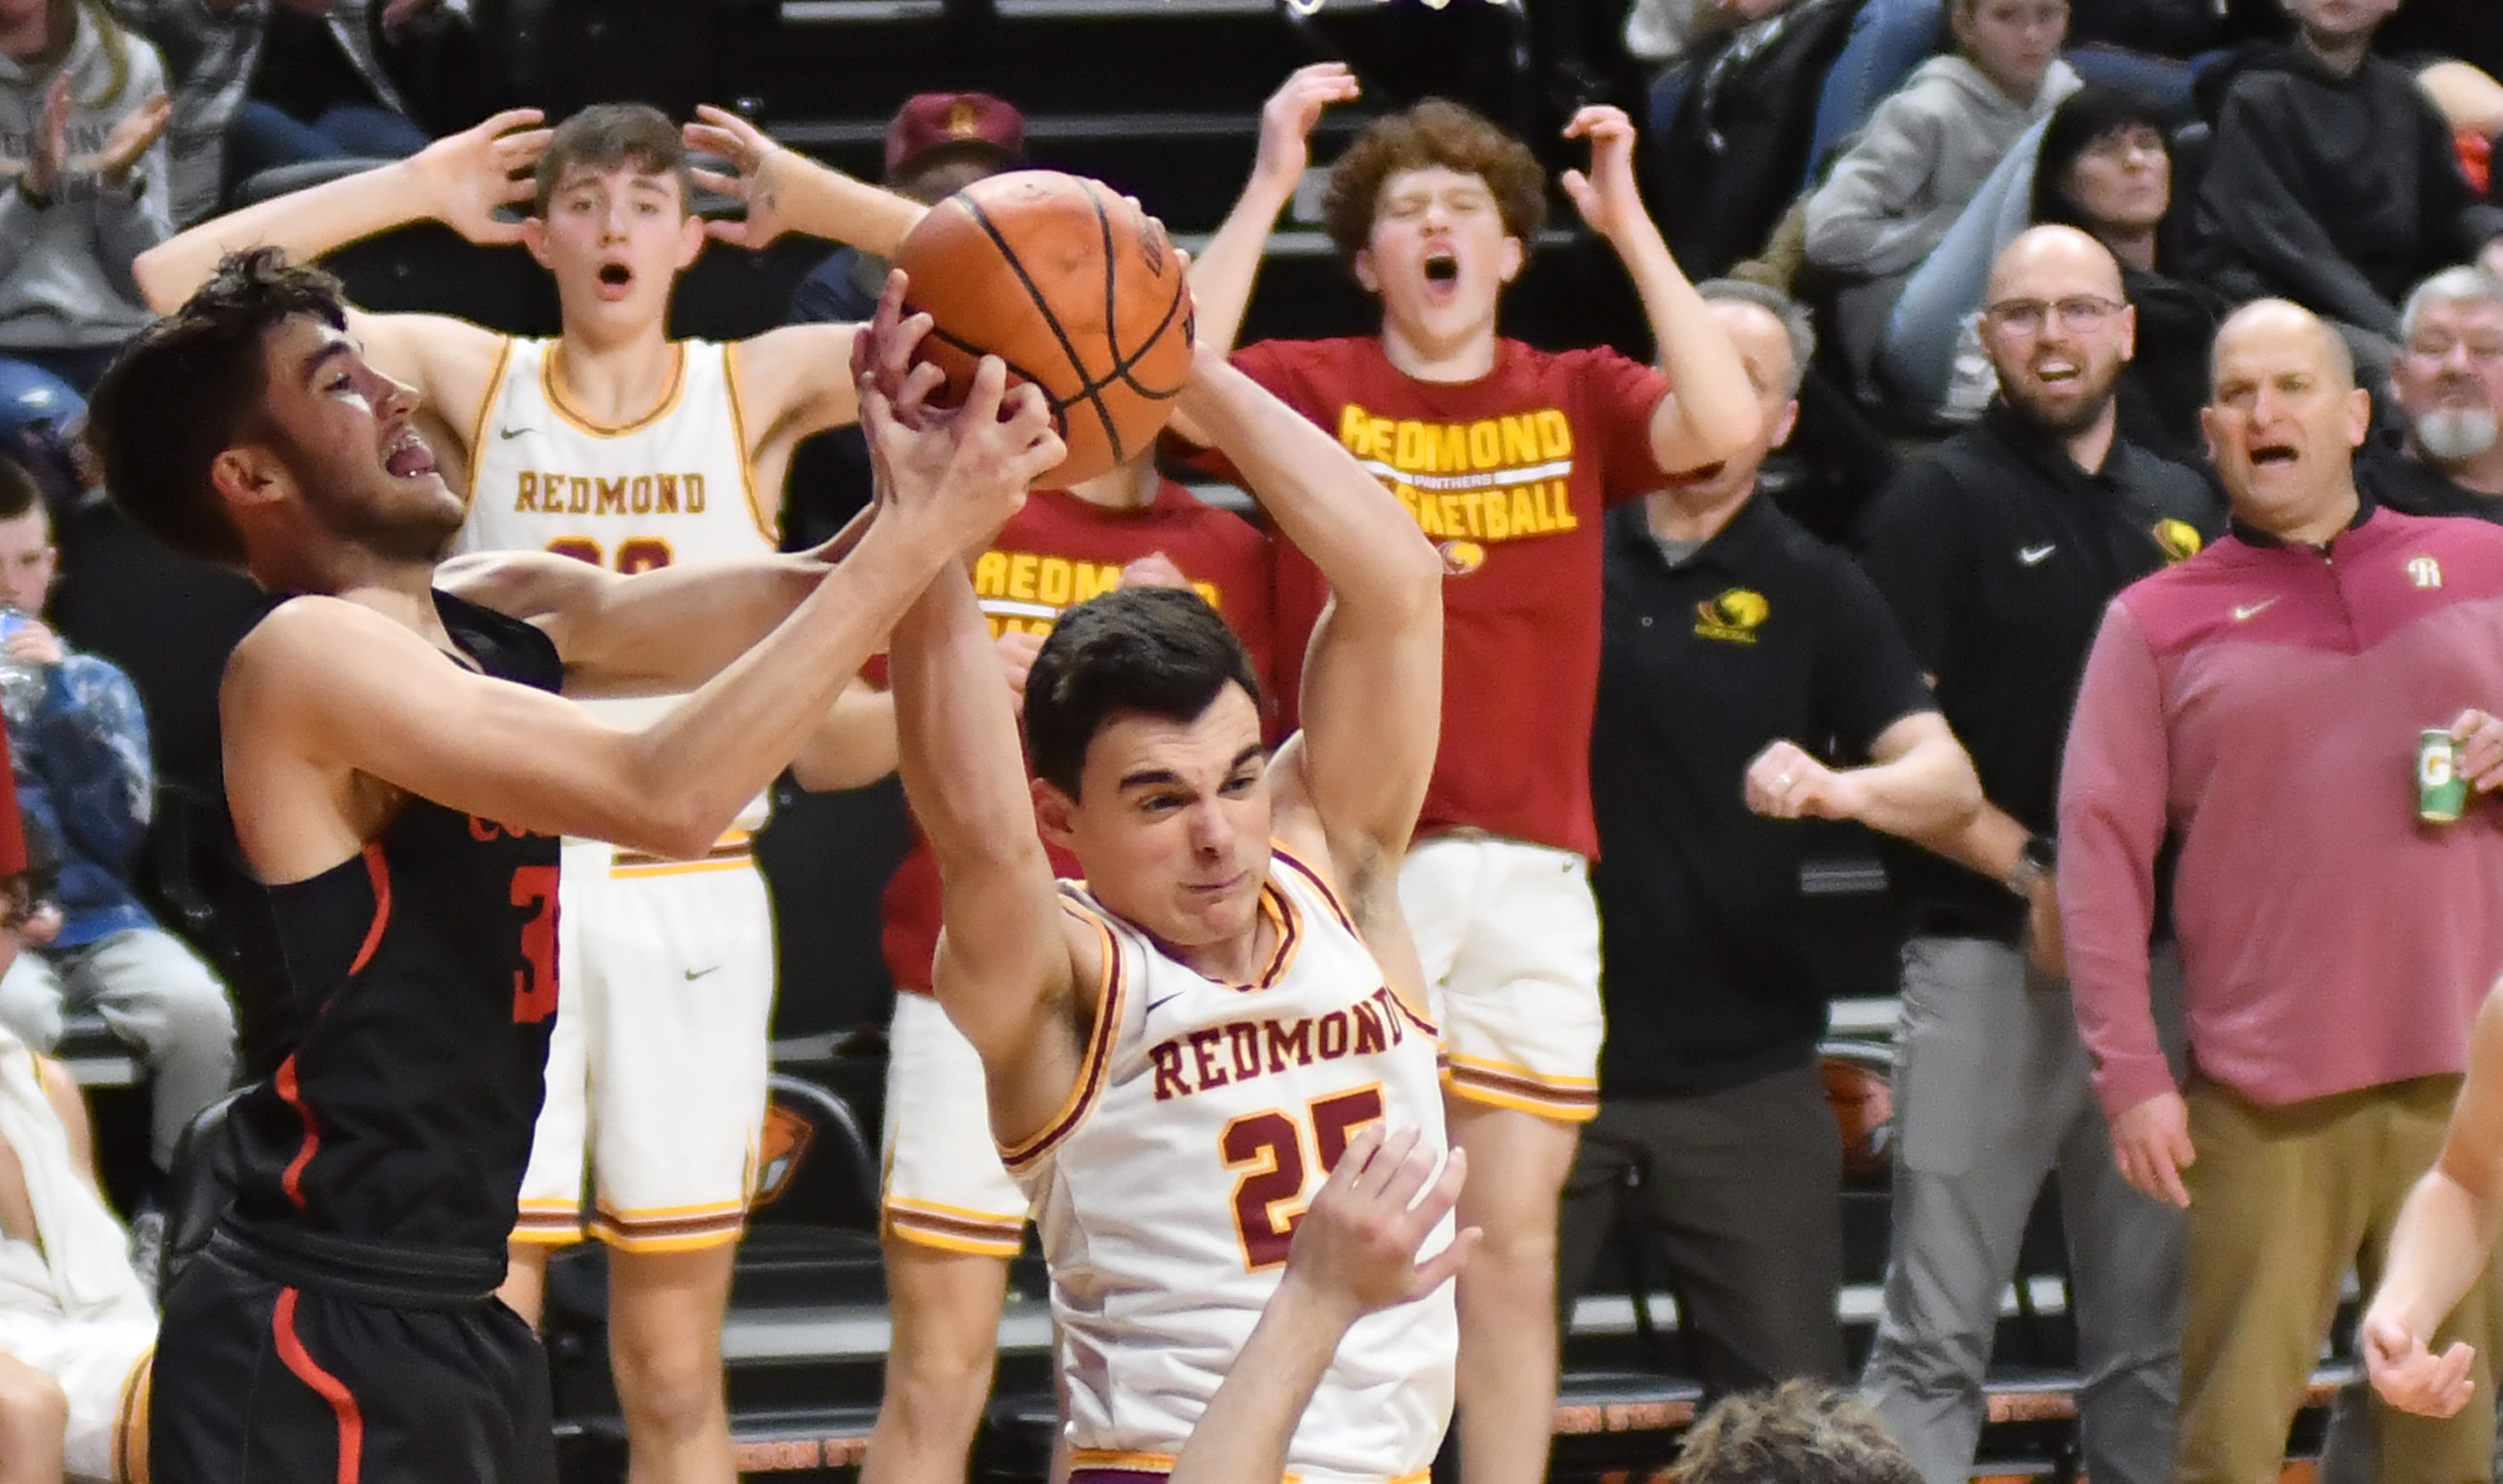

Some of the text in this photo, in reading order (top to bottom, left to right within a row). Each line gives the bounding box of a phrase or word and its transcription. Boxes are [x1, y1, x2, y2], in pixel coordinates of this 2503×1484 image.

[1341, 404, 1573, 473] REDMOND
[514, 470, 706, 516] REDMOND
[1413, 472, 1493, 490] PANTHERS
[1387, 478, 1578, 540] SKETBALL
[2406, 556, 2443, 587] R
[2420, 745, 2451, 786] G
